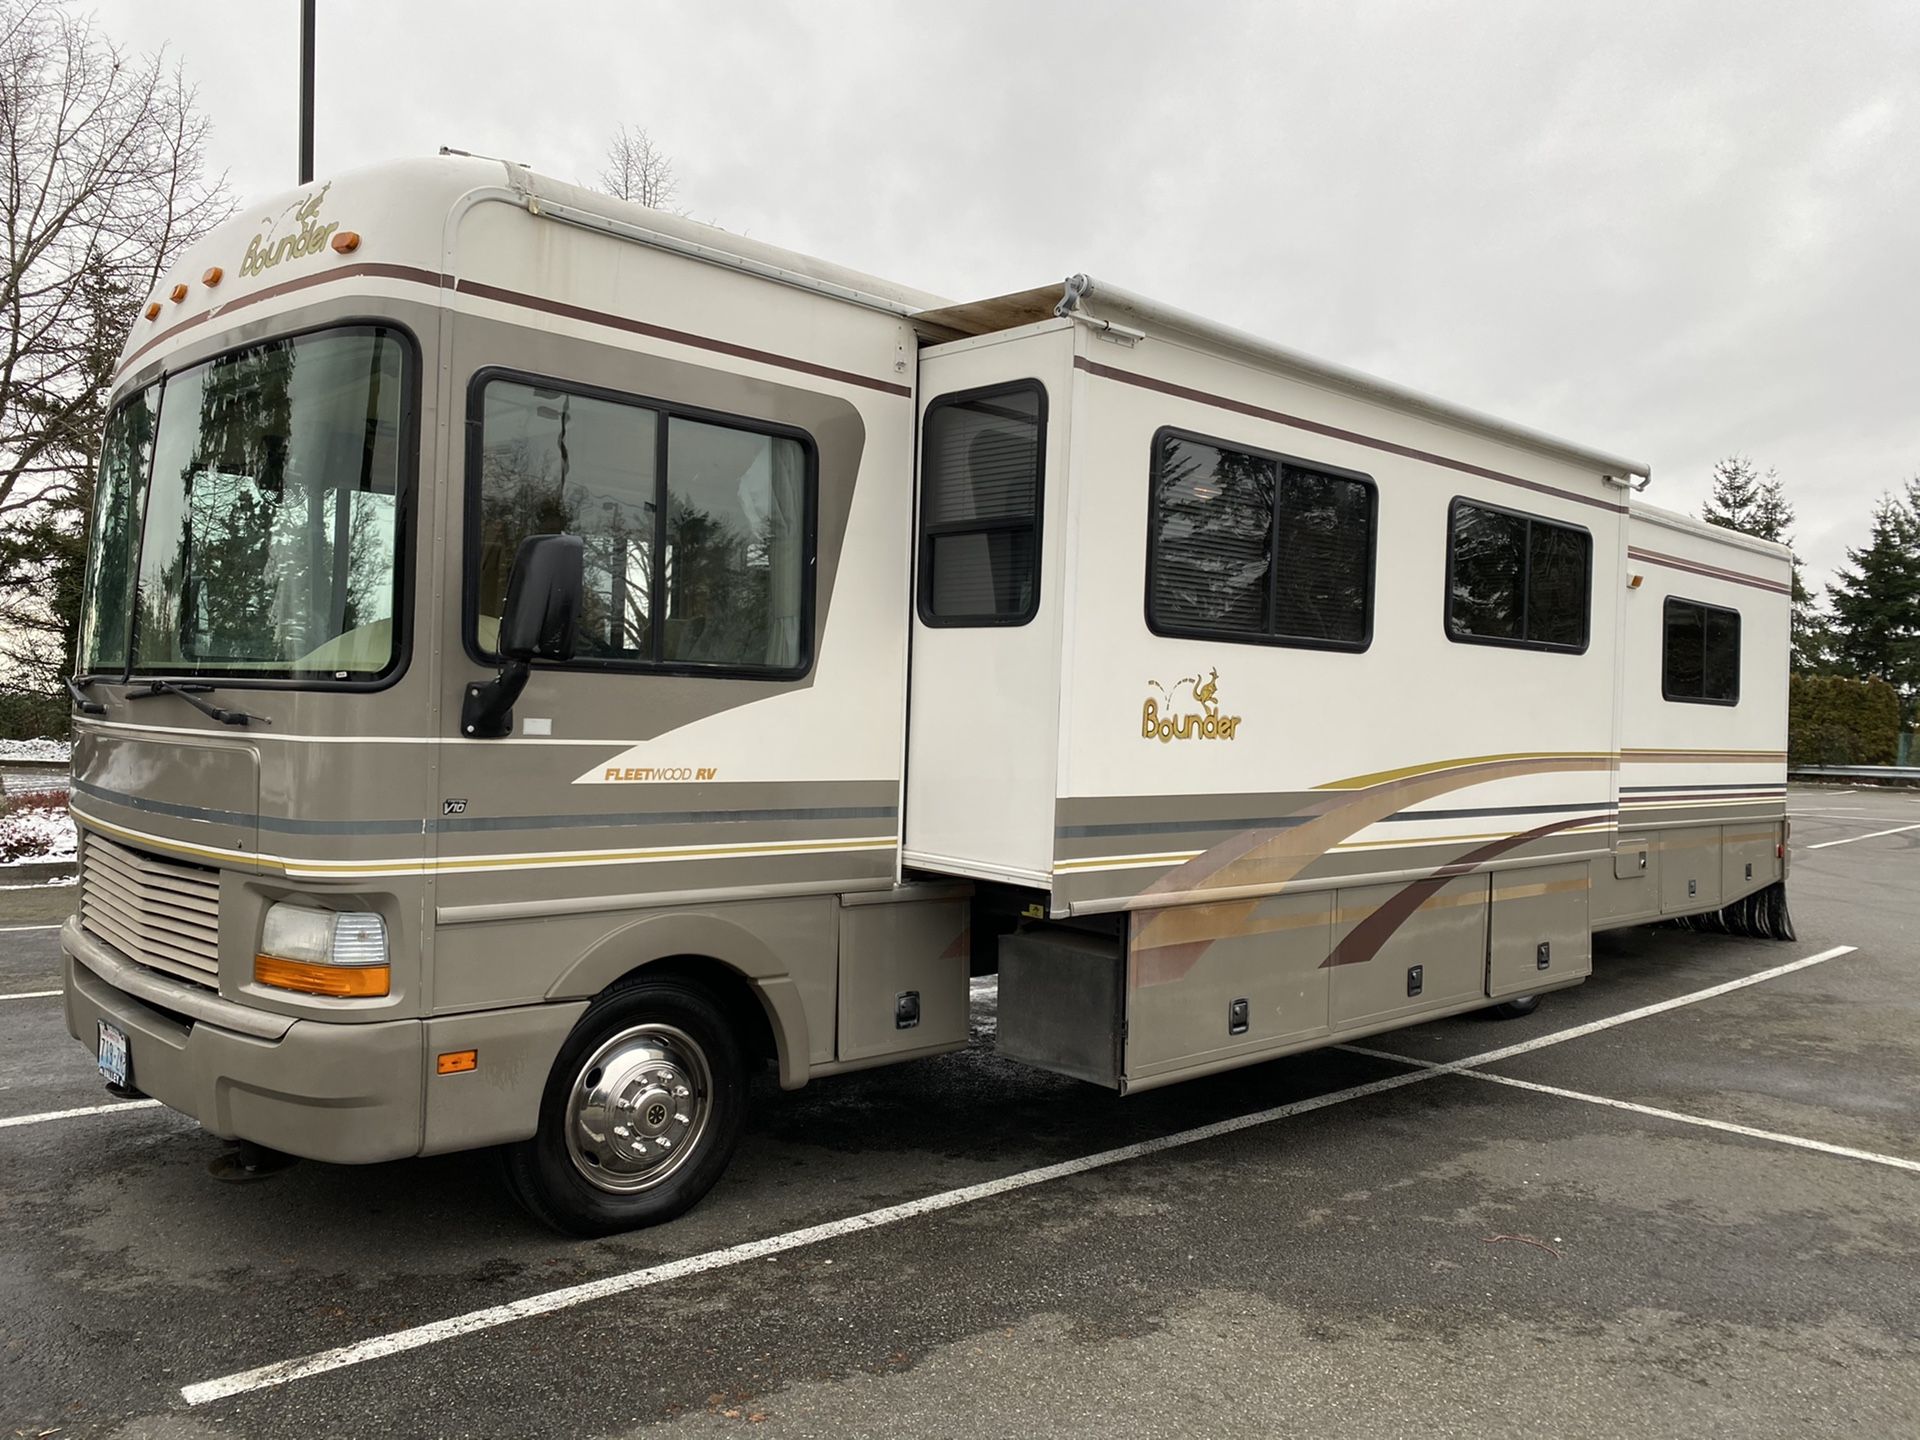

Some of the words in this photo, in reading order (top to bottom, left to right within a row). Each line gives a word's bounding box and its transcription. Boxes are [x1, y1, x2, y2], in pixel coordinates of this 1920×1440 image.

[239, 219, 340, 278] Bounder
[1142, 697, 1241, 743] Bounder
[605, 767, 692, 781] FLEETWOOD
[695, 767, 717, 781] RV
[443, 801, 467, 815] V10
